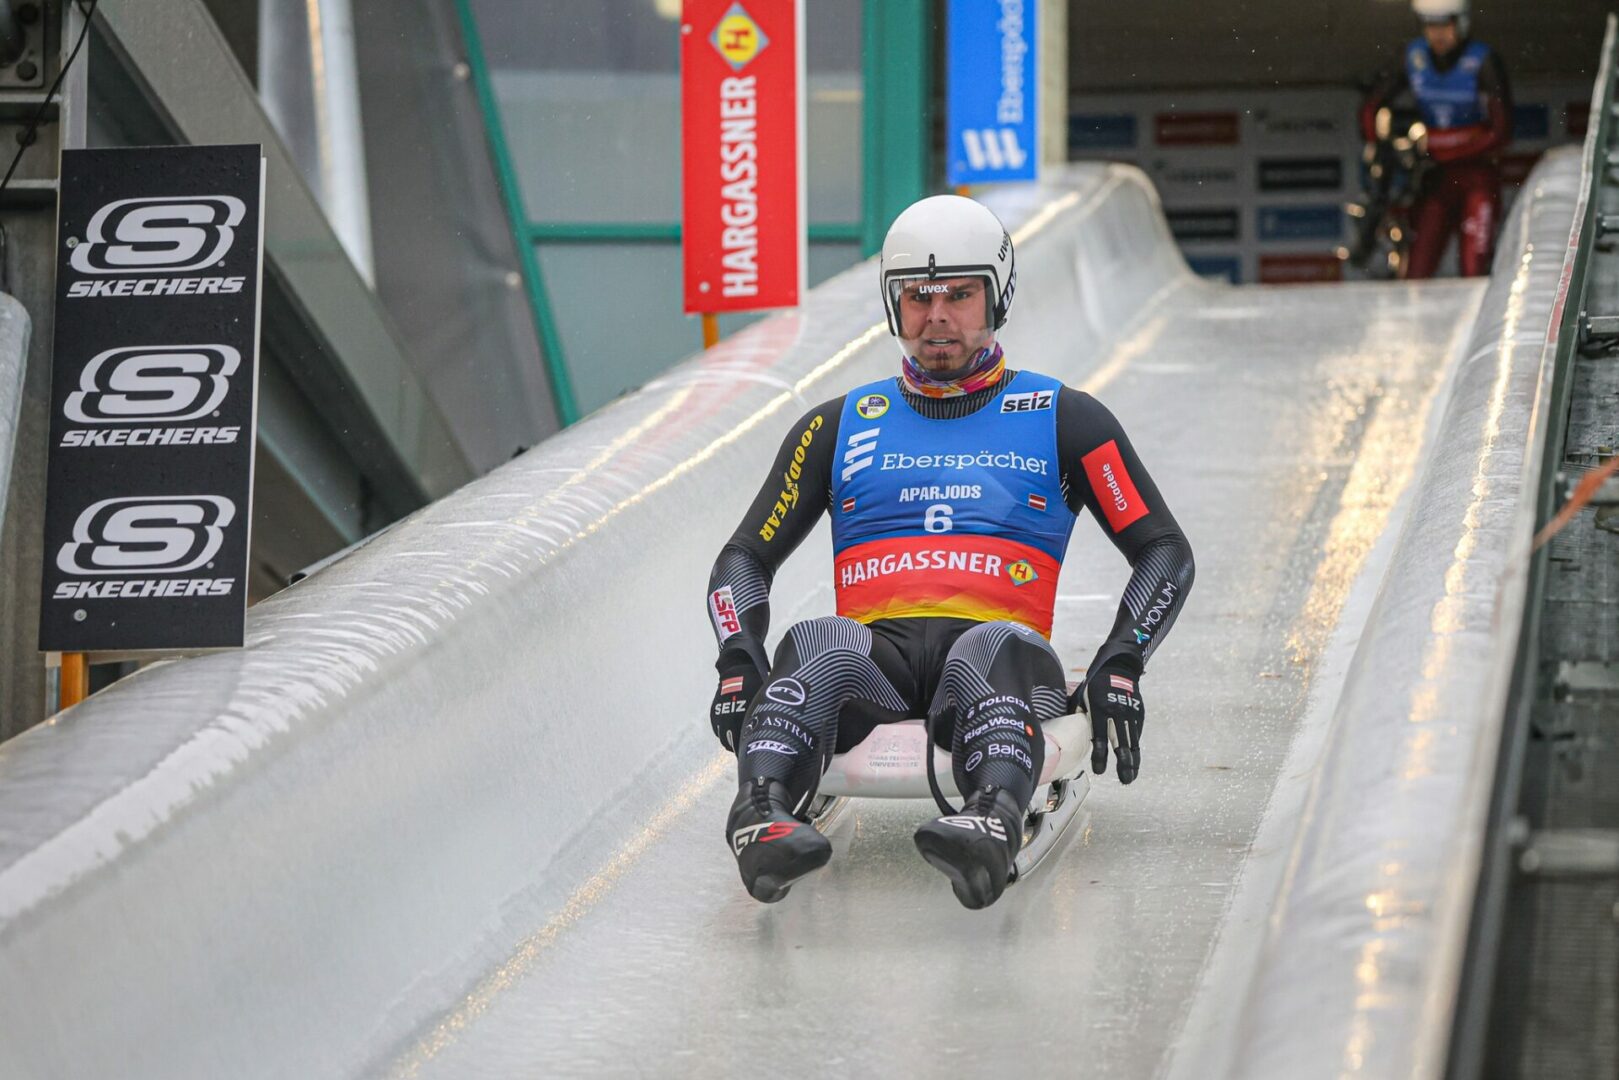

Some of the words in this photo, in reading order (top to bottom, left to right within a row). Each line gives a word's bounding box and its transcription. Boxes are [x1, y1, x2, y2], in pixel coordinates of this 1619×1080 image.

[721, 76, 758, 297] HARGASSNER
[66, 276, 246, 298] SKECHERS
[919, 283, 949, 295] uvex
[60, 426, 240, 448] SKECHERS
[880, 450, 1048, 476] Eberspächer
[759, 415, 825, 543] GOODYEAR
[1102, 463, 1128, 513] Citadele
[899, 485, 982, 503] APARJODS
[923, 504, 954, 533] 6
[841, 550, 1002, 588] HARGASSNER
[52, 579, 234, 599] SKECHERS
[1141, 581, 1178, 632] MONUM
[964, 723, 989, 744] Riga
[988, 716, 1025, 730] Wood
[988, 743, 1032, 769] Balcia
